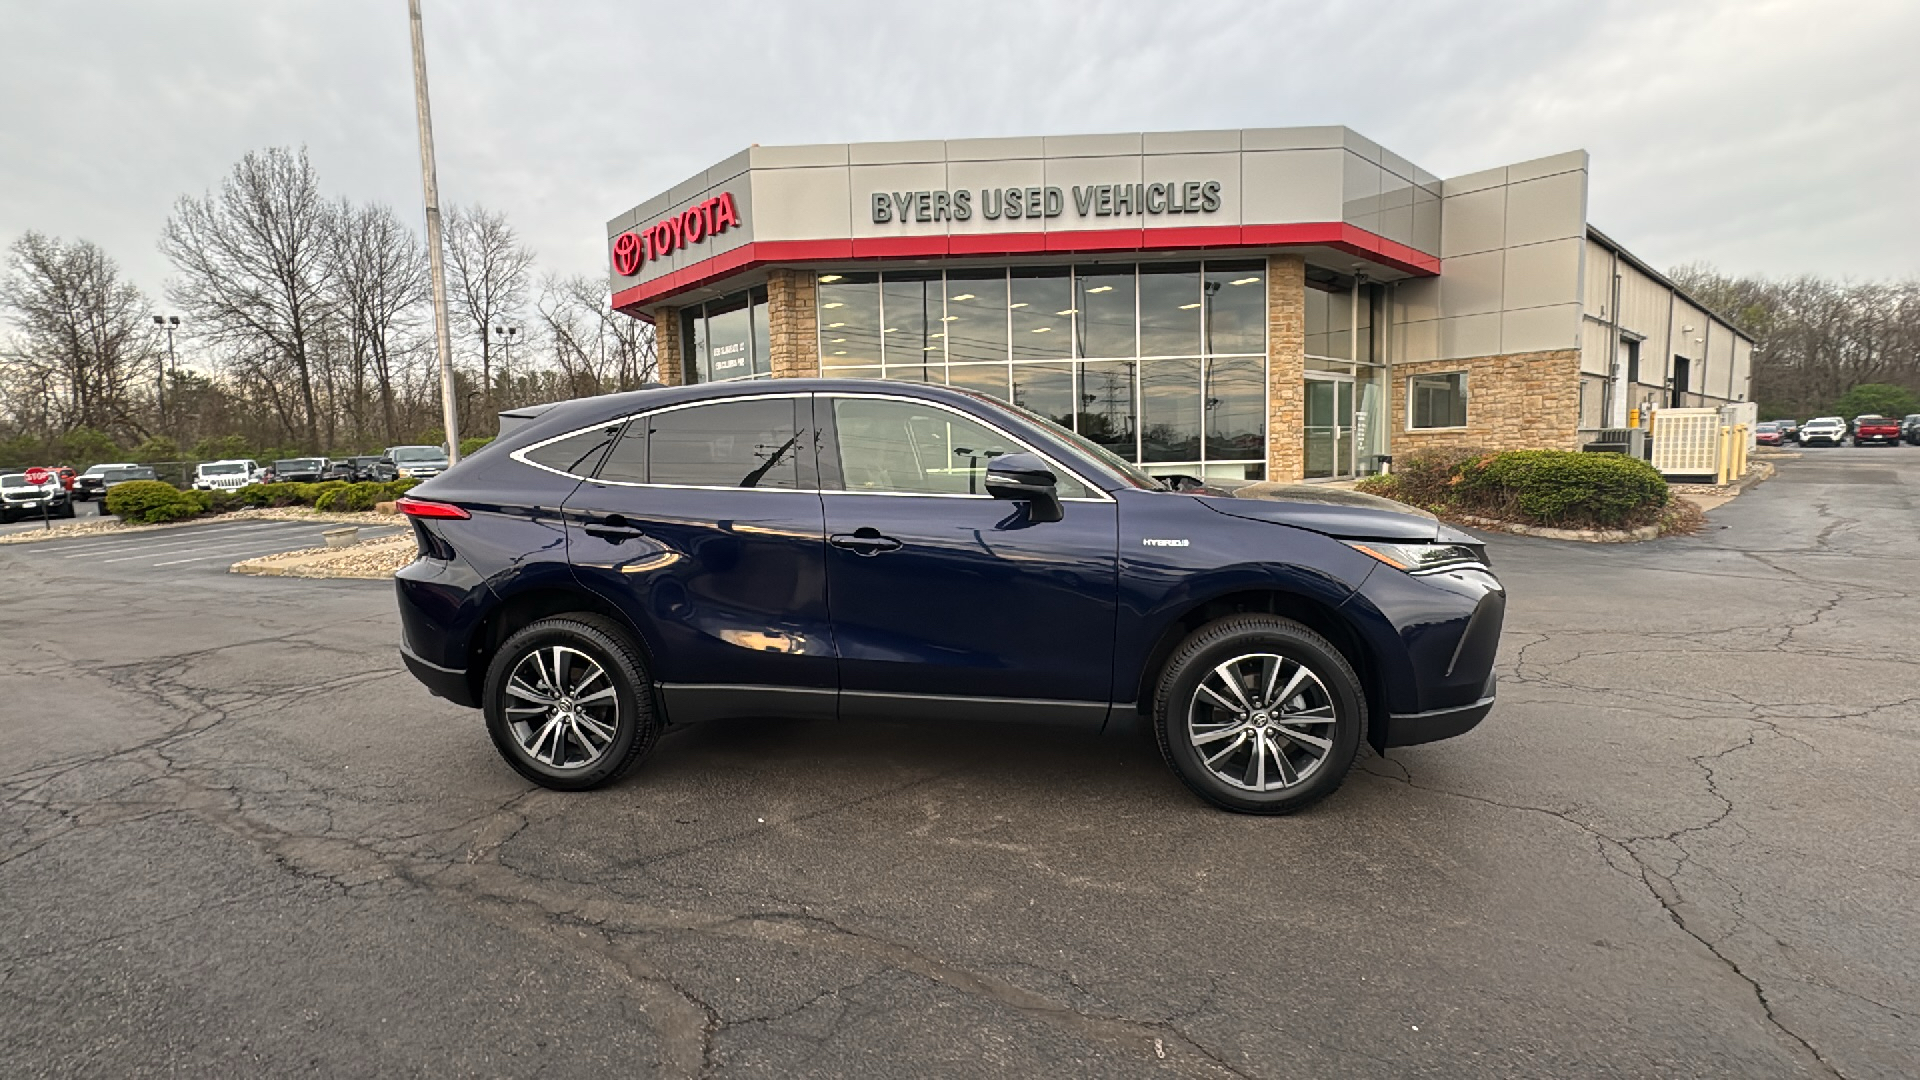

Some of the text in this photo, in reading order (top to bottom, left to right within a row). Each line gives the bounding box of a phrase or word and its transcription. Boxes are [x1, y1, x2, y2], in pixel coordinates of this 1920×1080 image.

[871, 181, 1222, 223] BYERS USED VEHICLES
[641, 191, 738, 261] TOYOTA
[25, 472, 48, 481] STOP
